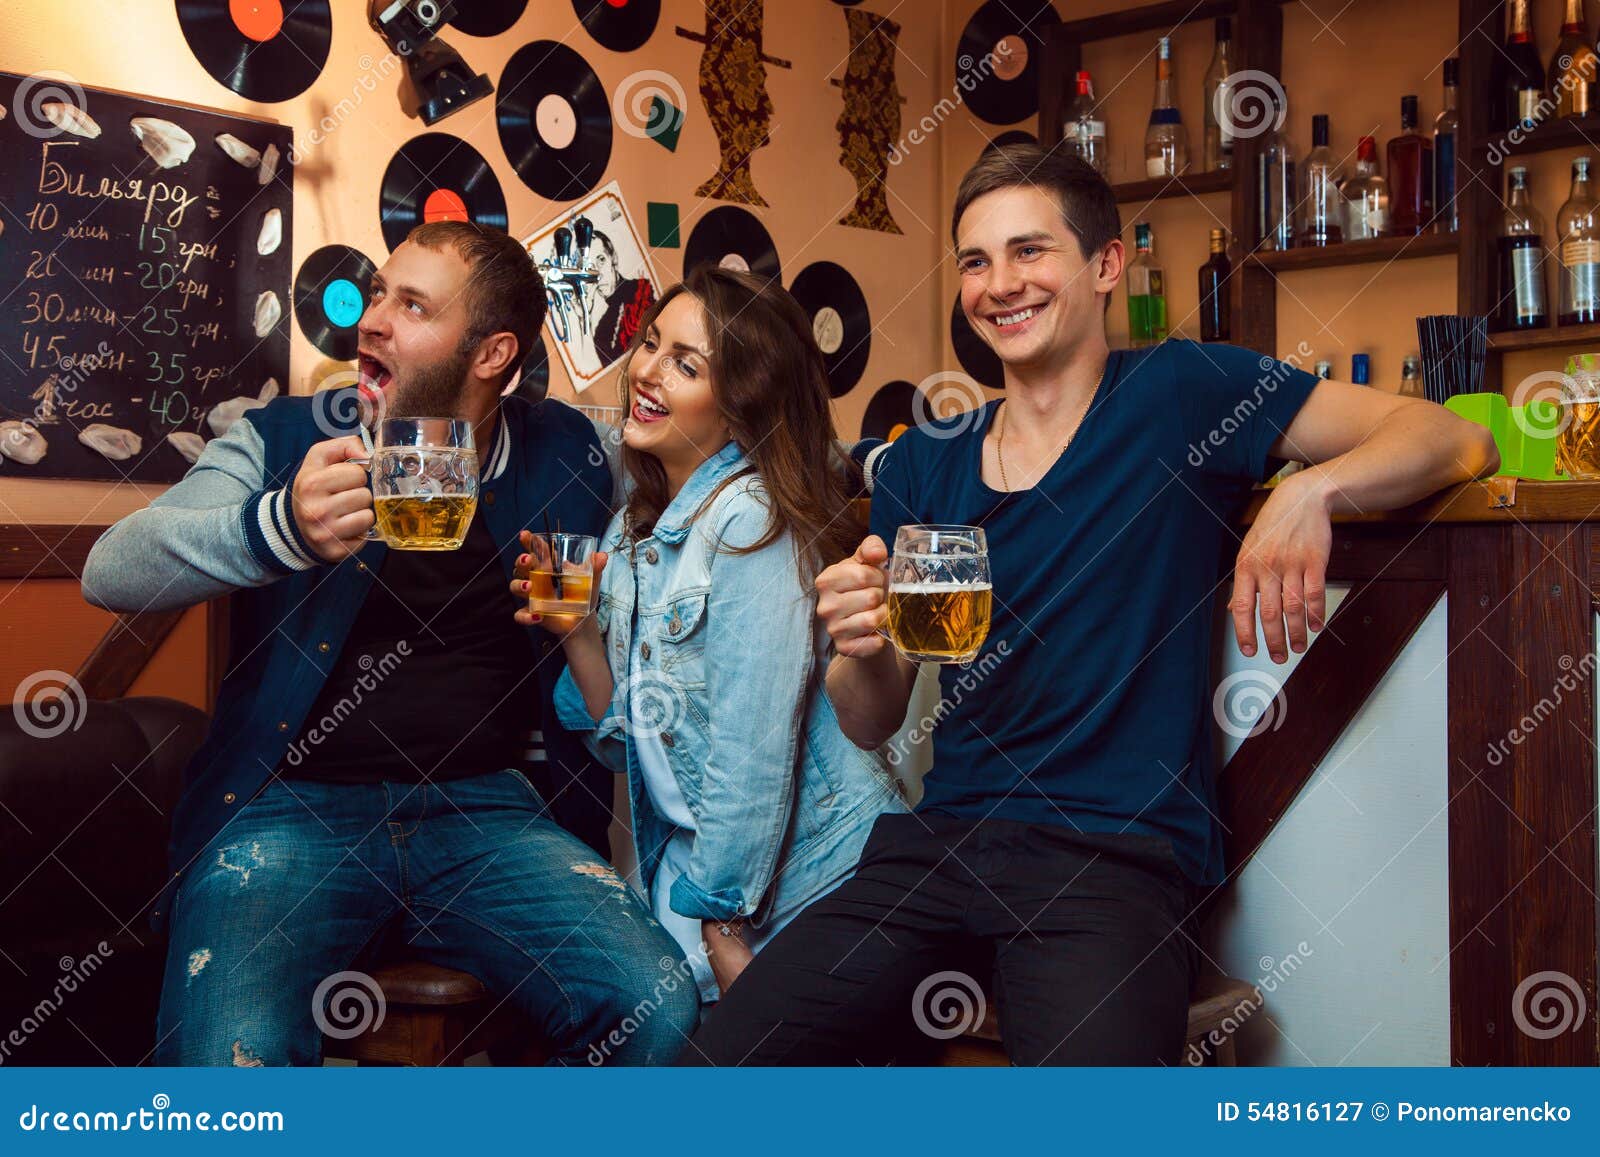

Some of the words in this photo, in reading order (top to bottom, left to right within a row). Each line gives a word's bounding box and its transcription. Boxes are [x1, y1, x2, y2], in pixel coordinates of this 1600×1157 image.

[26, 203, 59, 231] 10
[139, 224, 173, 253] 15
[137, 263, 175, 289] 20
[21, 292, 65, 324] 30
[142, 306, 182, 336] 25
[23, 331, 66, 369] 45
[146, 351, 187, 384] 35
[150, 391, 190, 425] 40
